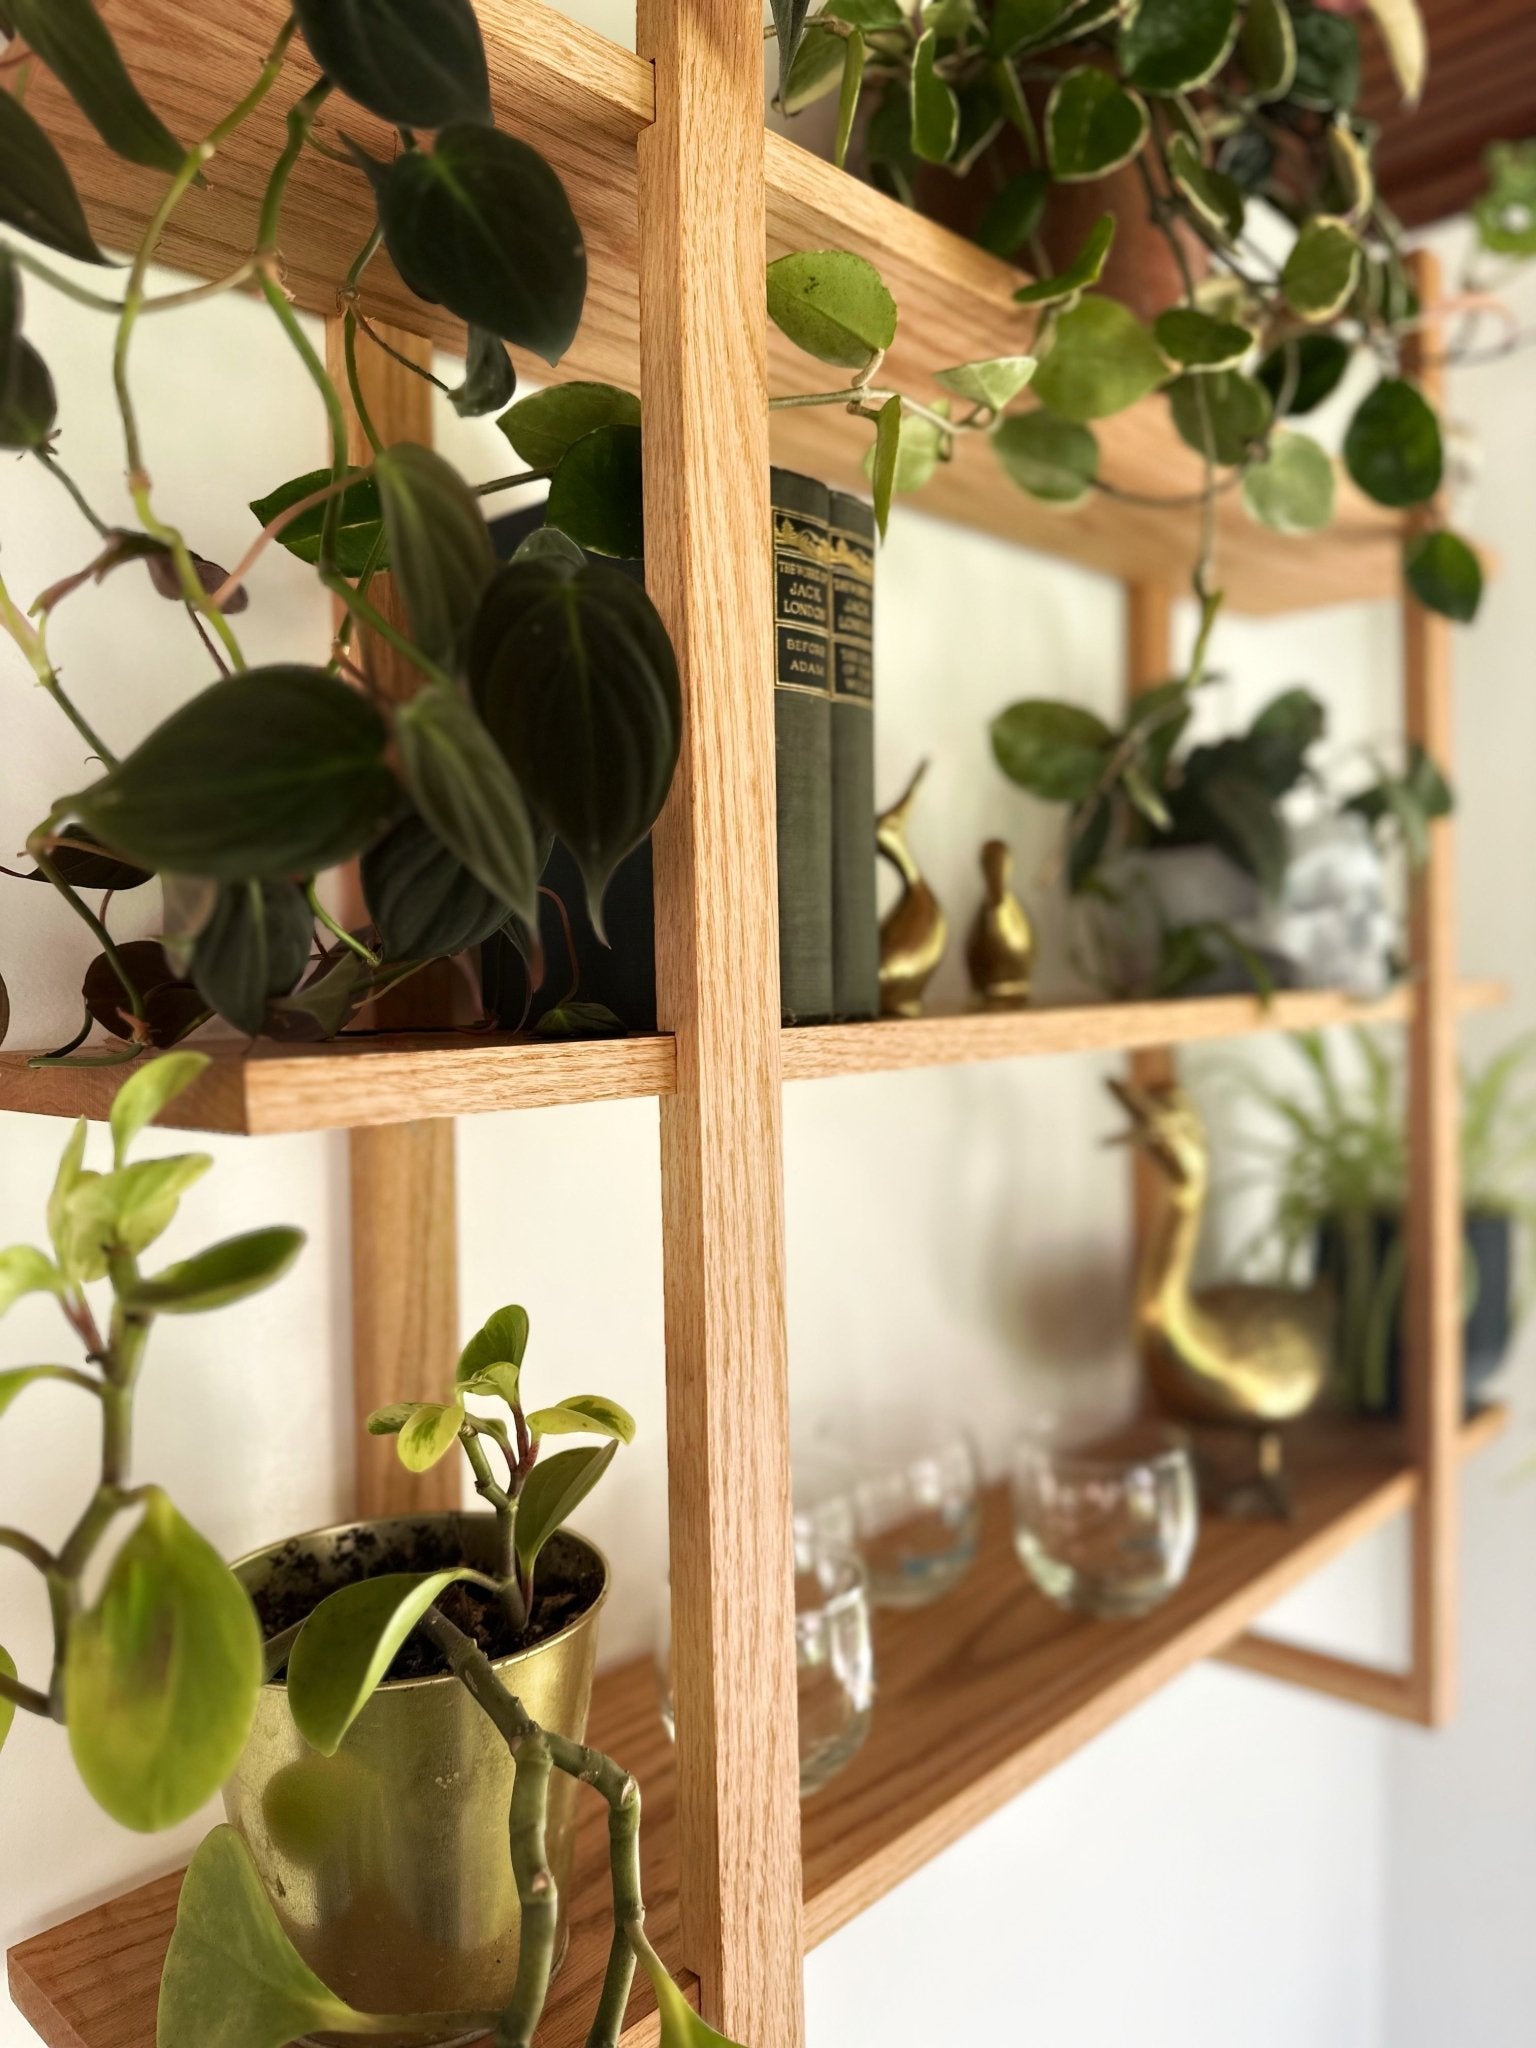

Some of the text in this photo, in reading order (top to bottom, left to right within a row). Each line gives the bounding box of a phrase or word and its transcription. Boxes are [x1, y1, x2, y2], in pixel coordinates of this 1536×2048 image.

[778, 560, 796, 576] THE
[789, 582, 822, 603] JACK
[790, 659, 825, 678] ADAM
